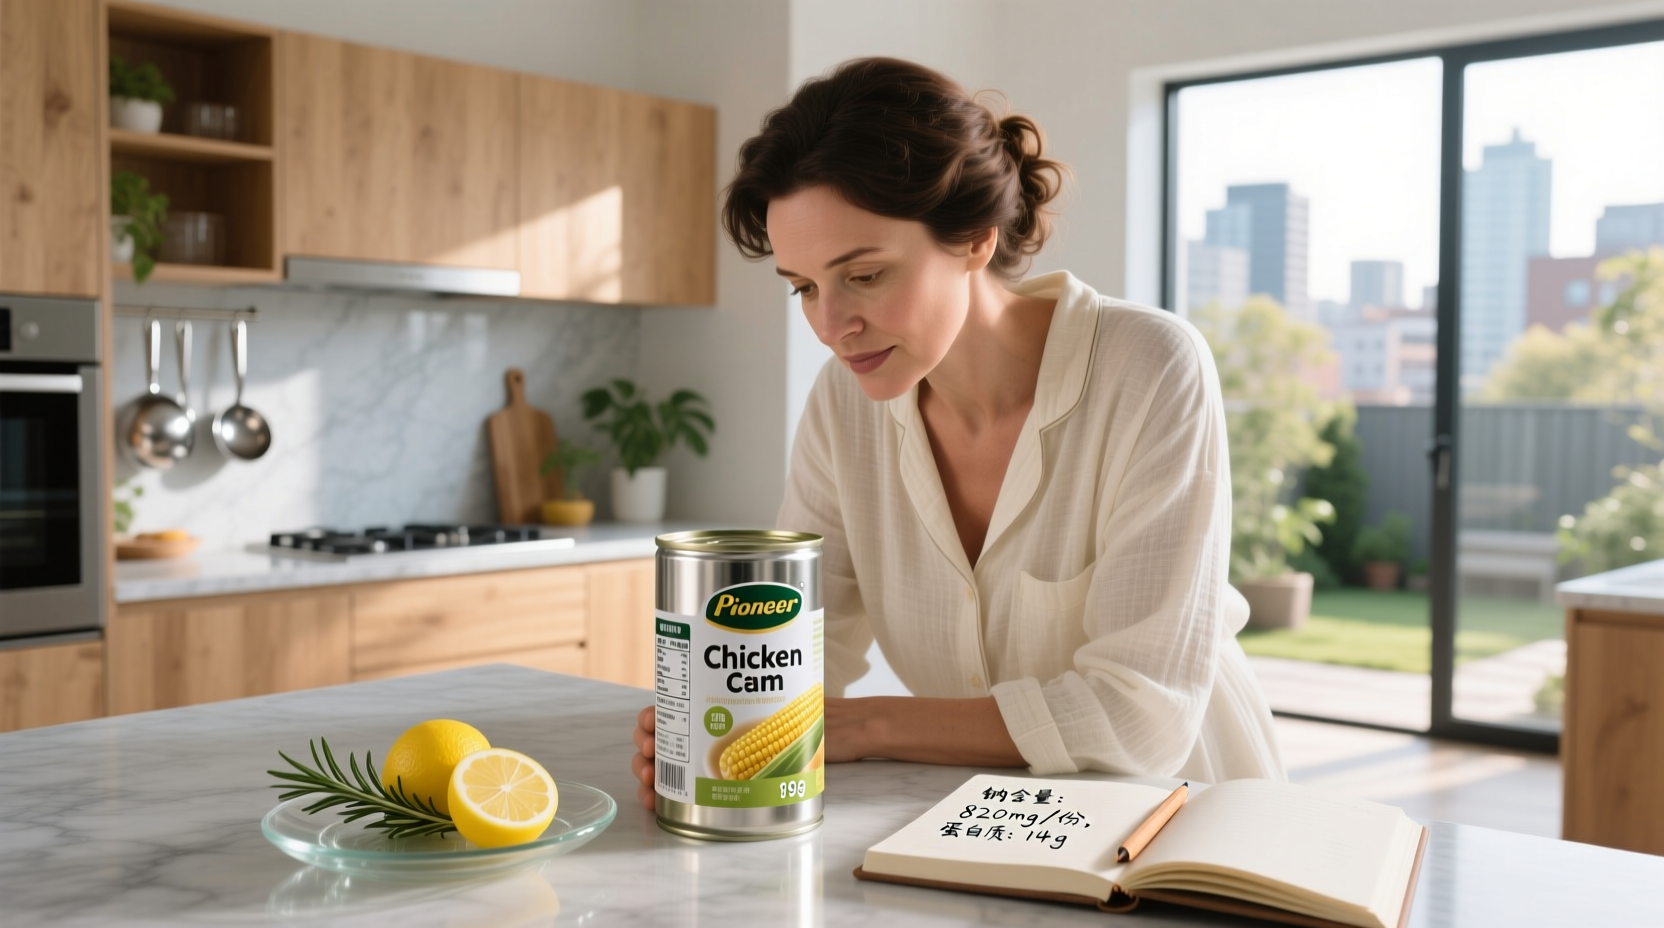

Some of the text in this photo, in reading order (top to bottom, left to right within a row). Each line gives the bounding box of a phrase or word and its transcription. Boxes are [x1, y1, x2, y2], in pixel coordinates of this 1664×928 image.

[713, 594, 799, 617] Pioneer
[703, 644, 802, 670] Chicken
[726, 671, 784, 693] Cam
